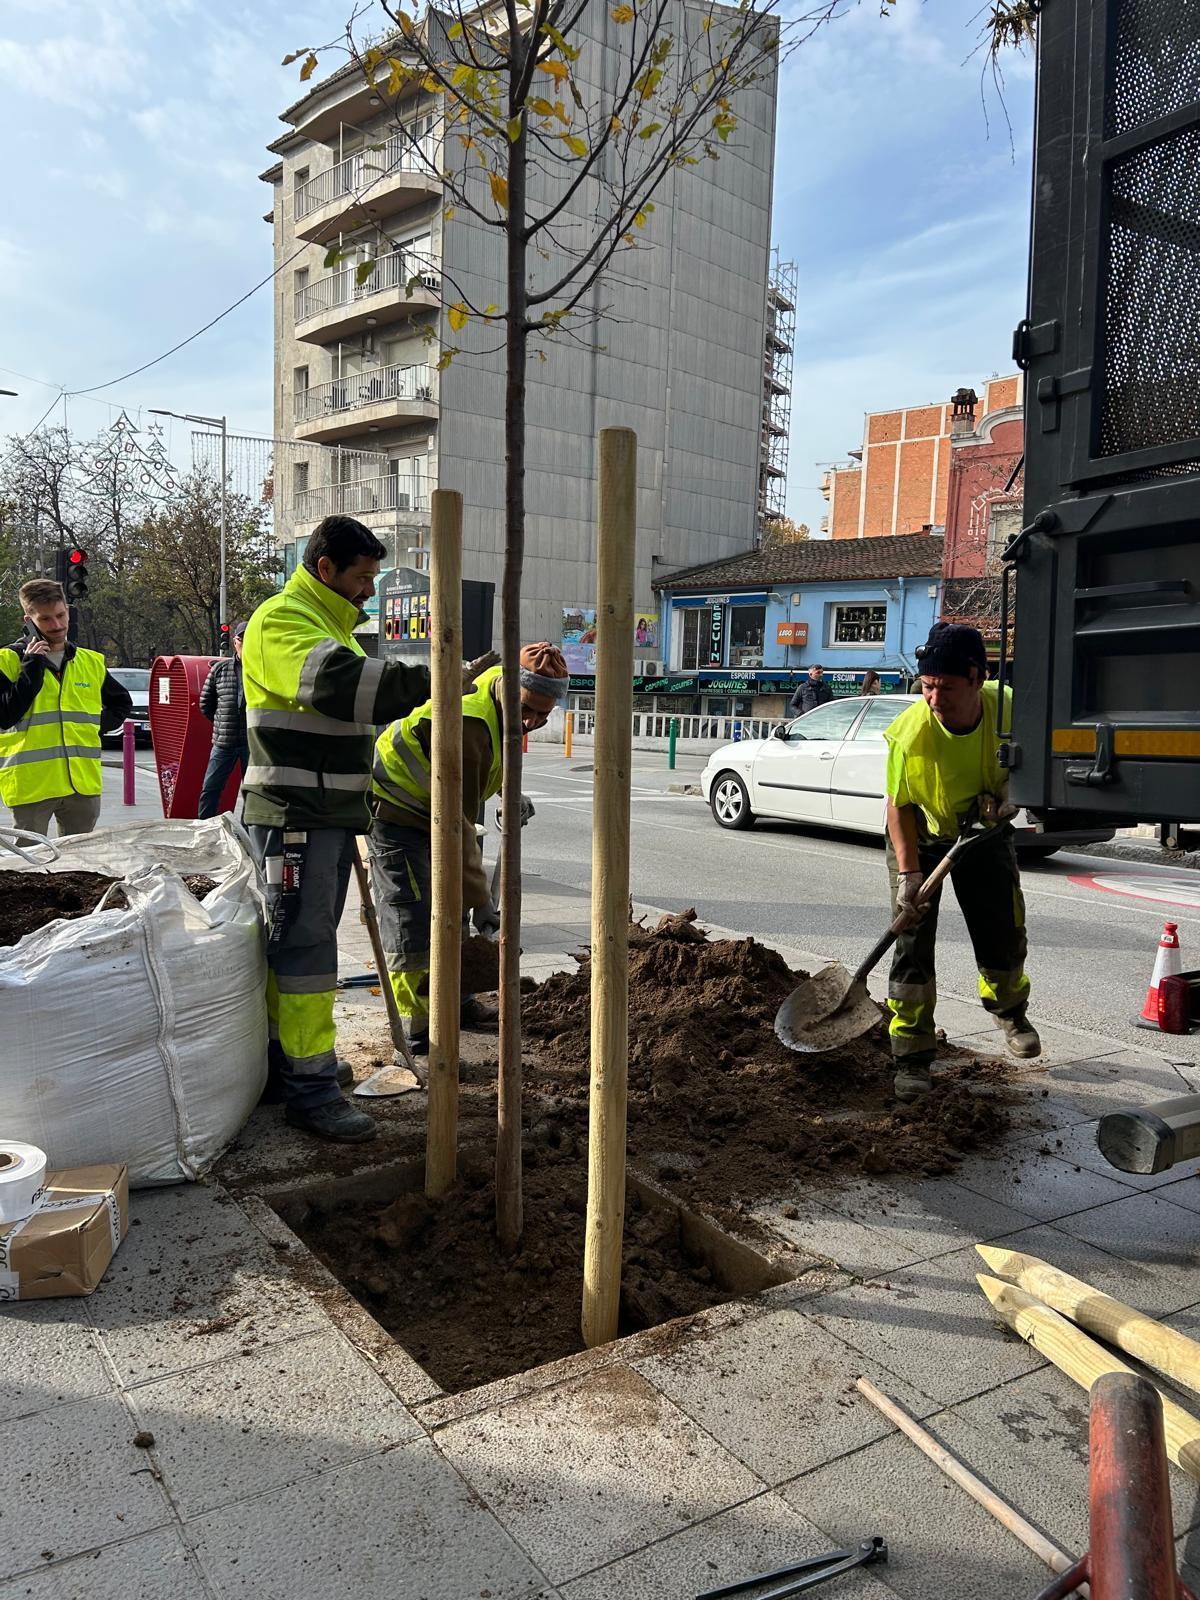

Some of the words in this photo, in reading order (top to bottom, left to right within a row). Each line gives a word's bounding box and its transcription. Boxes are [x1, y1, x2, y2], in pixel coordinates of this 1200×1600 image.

[711, 604, 722, 661] ESCUIN
[778, 629, 792, 637] LEGO
[731, 672, 756, 680] ESPORTS
[832, 673, 856, 682] ESCUIN
[570, 678, 595, 687] ESPO
[708, 680, 748, 690] JOGUINES
